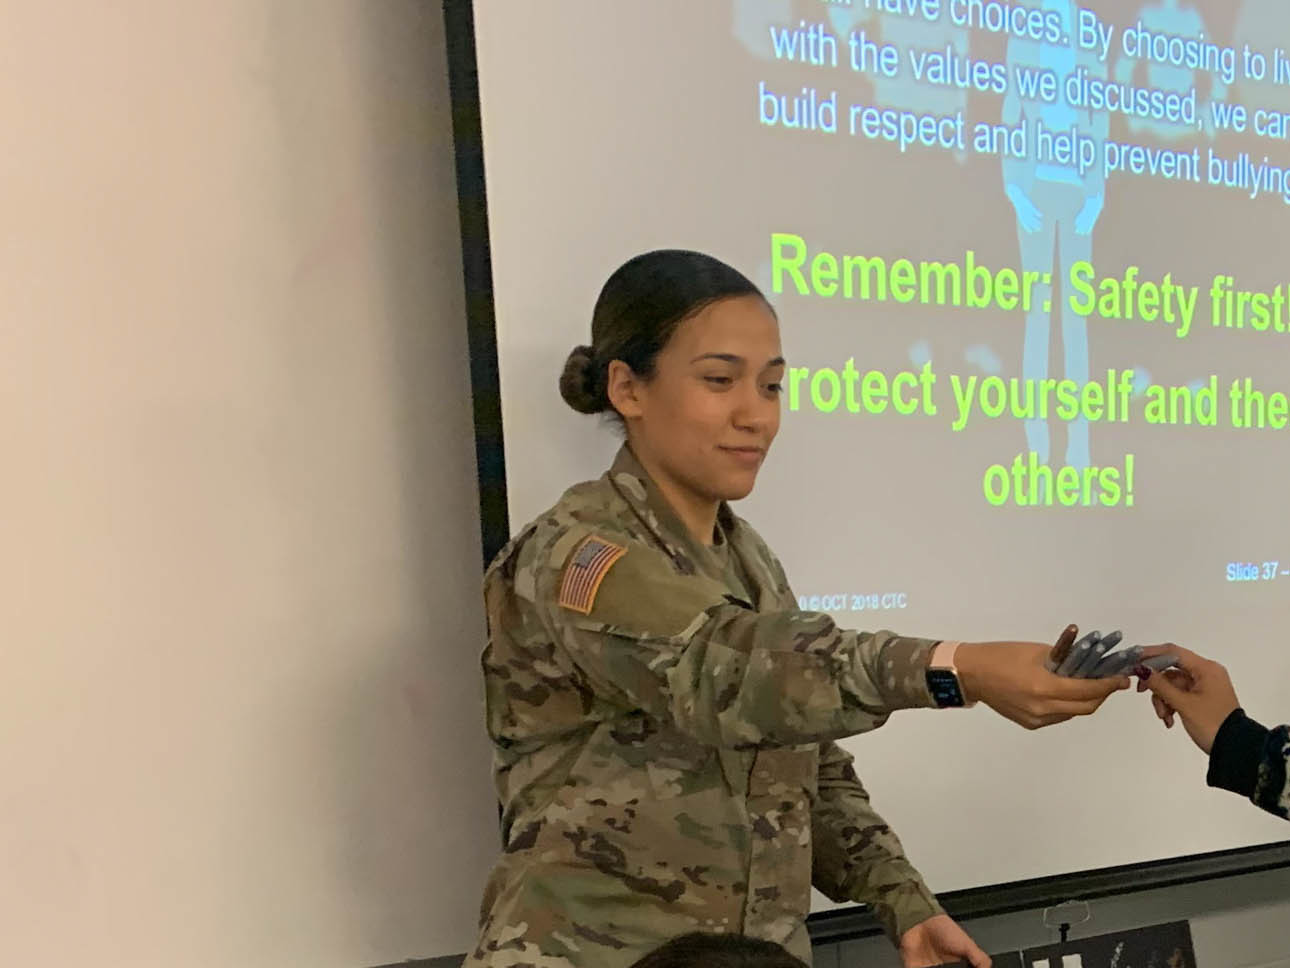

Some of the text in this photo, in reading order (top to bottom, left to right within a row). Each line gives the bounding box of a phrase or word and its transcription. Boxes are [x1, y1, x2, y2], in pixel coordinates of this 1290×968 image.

[770, 20, 838, 67] with
[849, 31, 898, 77] the
[909, 46, 1007, 93] values
[1016, 68, 1057, 100] we
[1066, 69, 1202, 130] discussed,
[1211, 101, 1247, 132] we
[950, 0, 1069, 44] choices.
[1078, 9, 1114, 60] By
[1122, 21, 1236, 84] choosing
[1244, 45, 1266, 80] to
[759, 81, 837, 133] build
[849, 104, 965, 152] respect
[973, 119, 1027, 157] and
[1037, 123, 1096, 175] help
[1104, 140, 1200, 182] prevent
[771, 233, 1052, 313] Remember:
[1069, 261, 1198, 338] Safety
[789, 357, 937, 416] rotect
[951, 368, 1135, 431] yourself
[1144, 375, 1218, 427] and
[982, 453, 1135, 507] others!
[822, 593, 848, 611] OCT
[851, 593, 878, 611] 2018
[881, 592, 907, 609] CTC
[1226, 561, 1259, 581] Slide
[1262, 561, 1279, 580] 37
